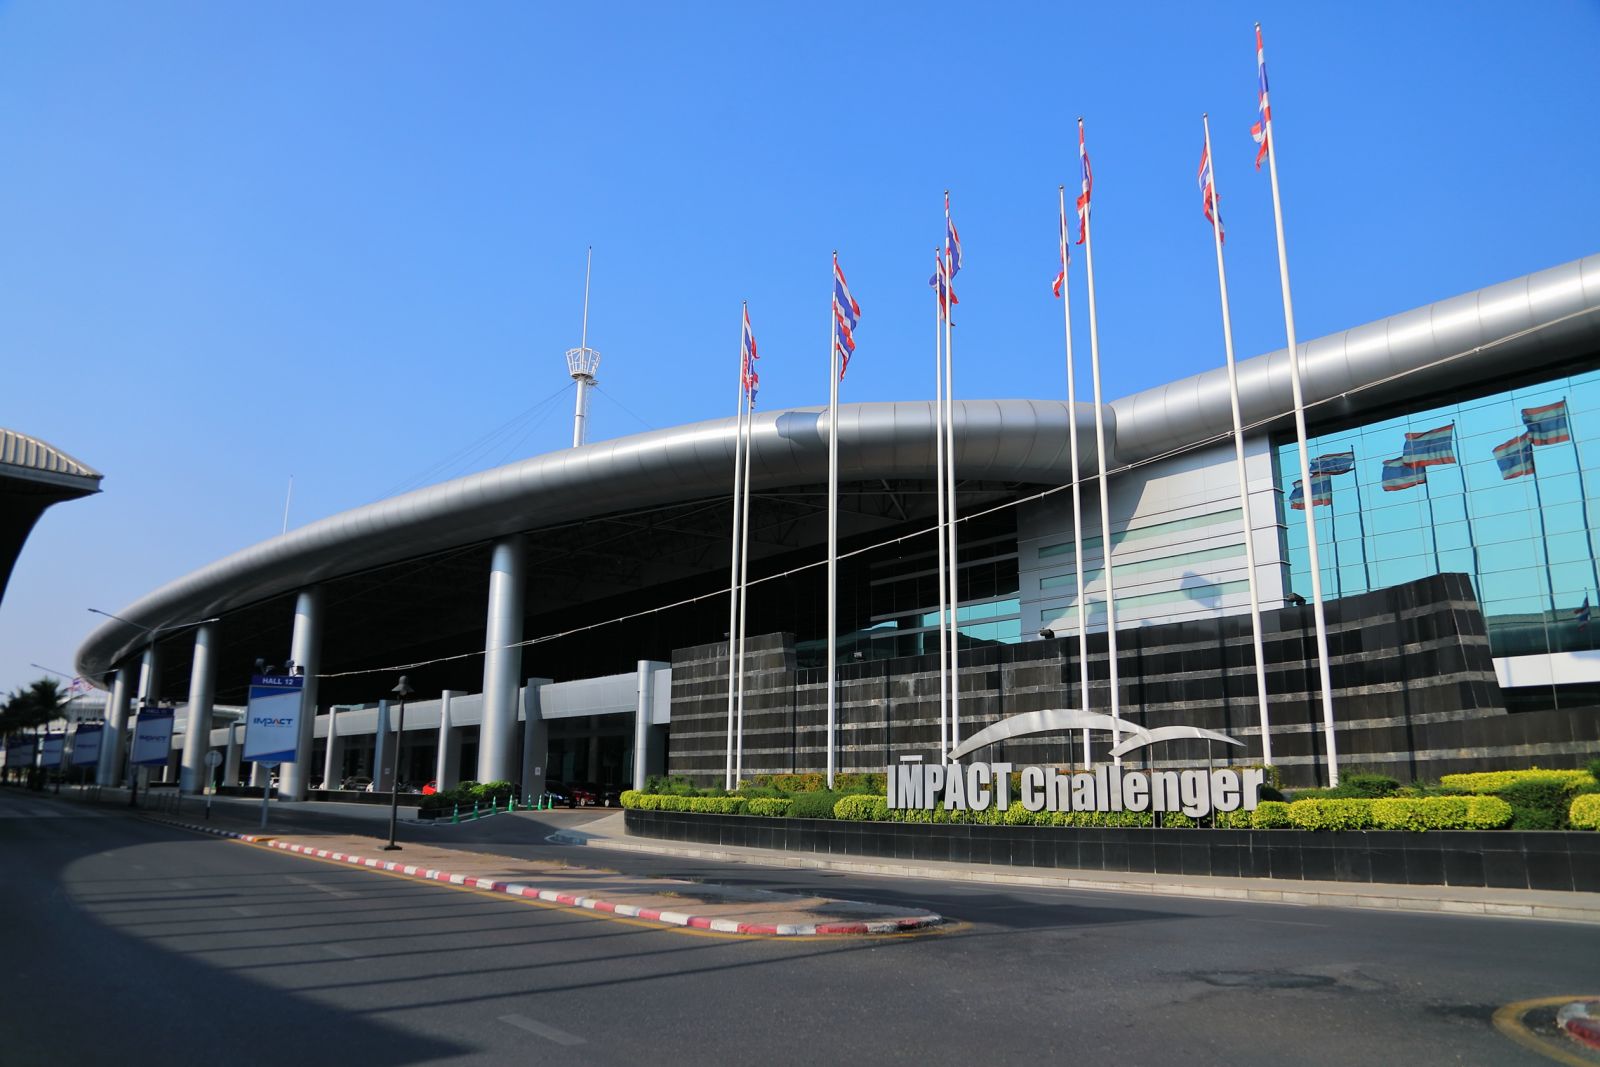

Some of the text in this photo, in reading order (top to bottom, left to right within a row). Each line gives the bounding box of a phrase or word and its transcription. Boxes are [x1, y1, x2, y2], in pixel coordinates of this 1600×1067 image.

[262, 677, 282, 685] HALL
[253, 717, 293, 727] IMPACT
[887, 762, 1264, 818] IMPACT Challenger
